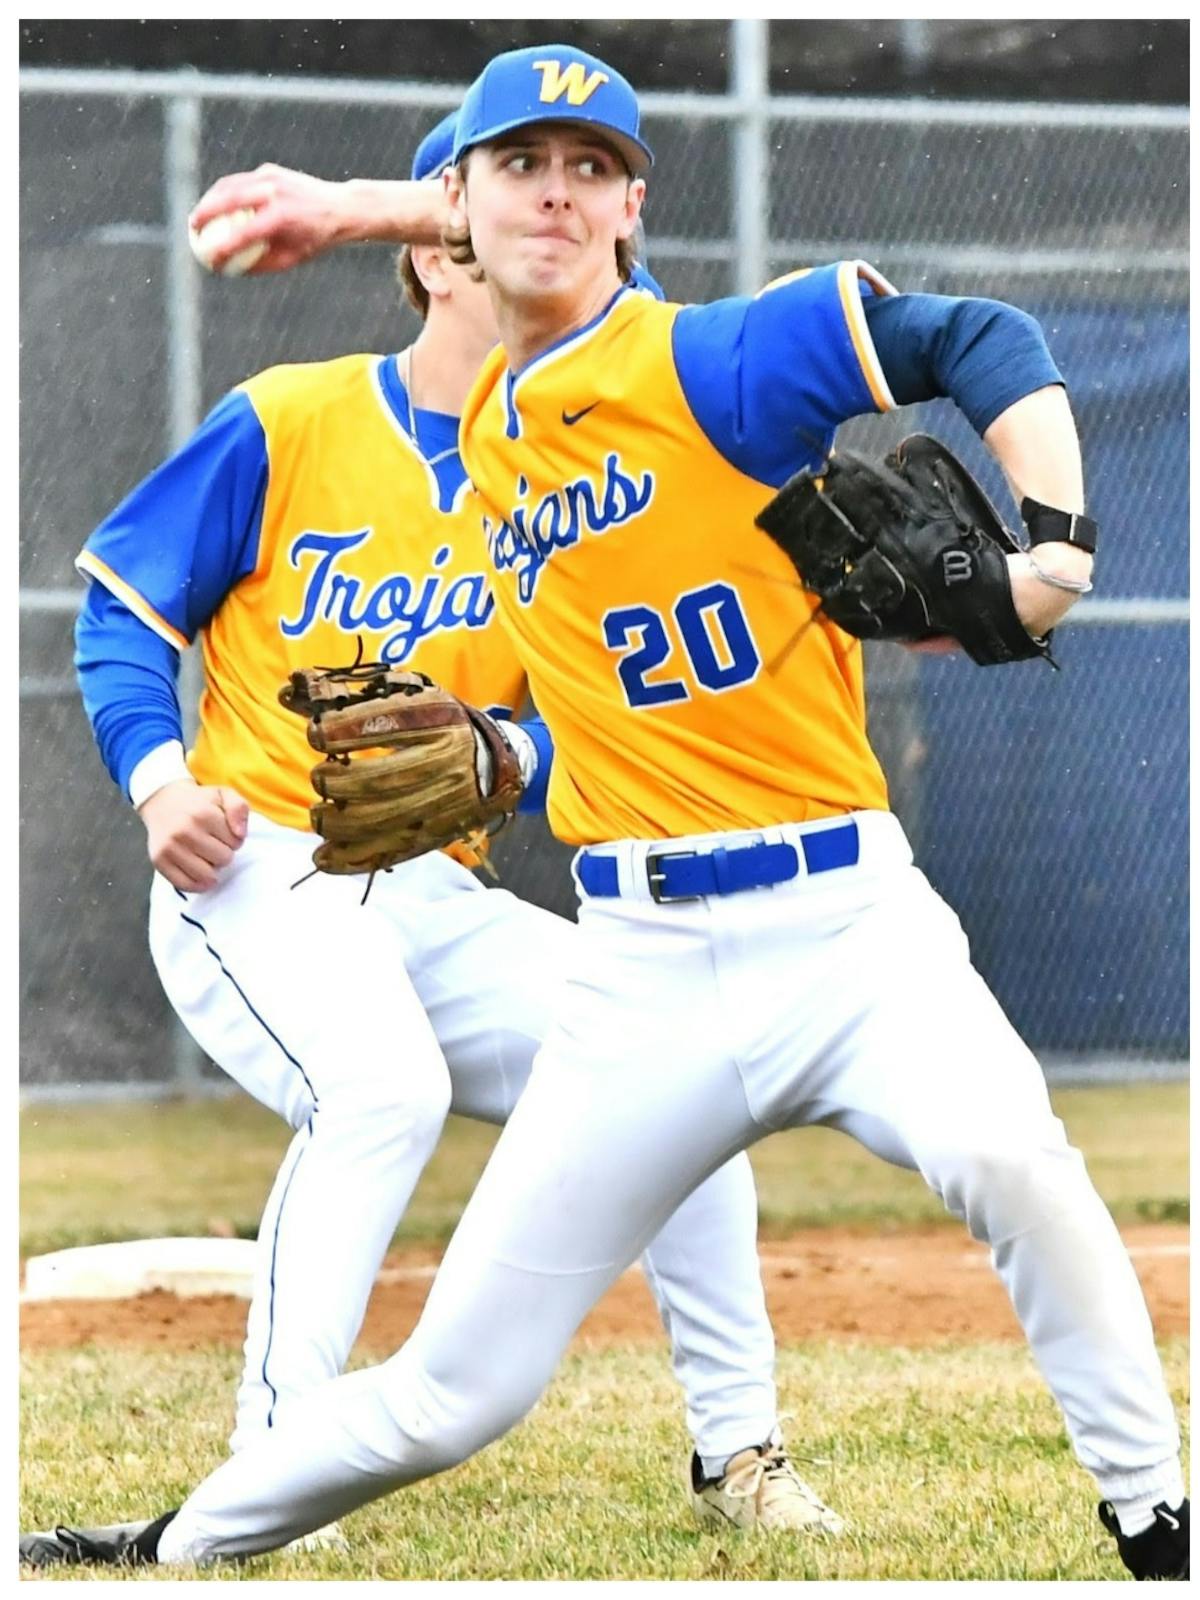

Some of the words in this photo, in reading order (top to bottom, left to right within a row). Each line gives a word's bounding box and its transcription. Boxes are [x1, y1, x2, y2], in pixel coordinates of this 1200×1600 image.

[532, 60, 610, 107] W
[279, 528, 496, 664] Troja
[601, 579, 764, 711] 20
